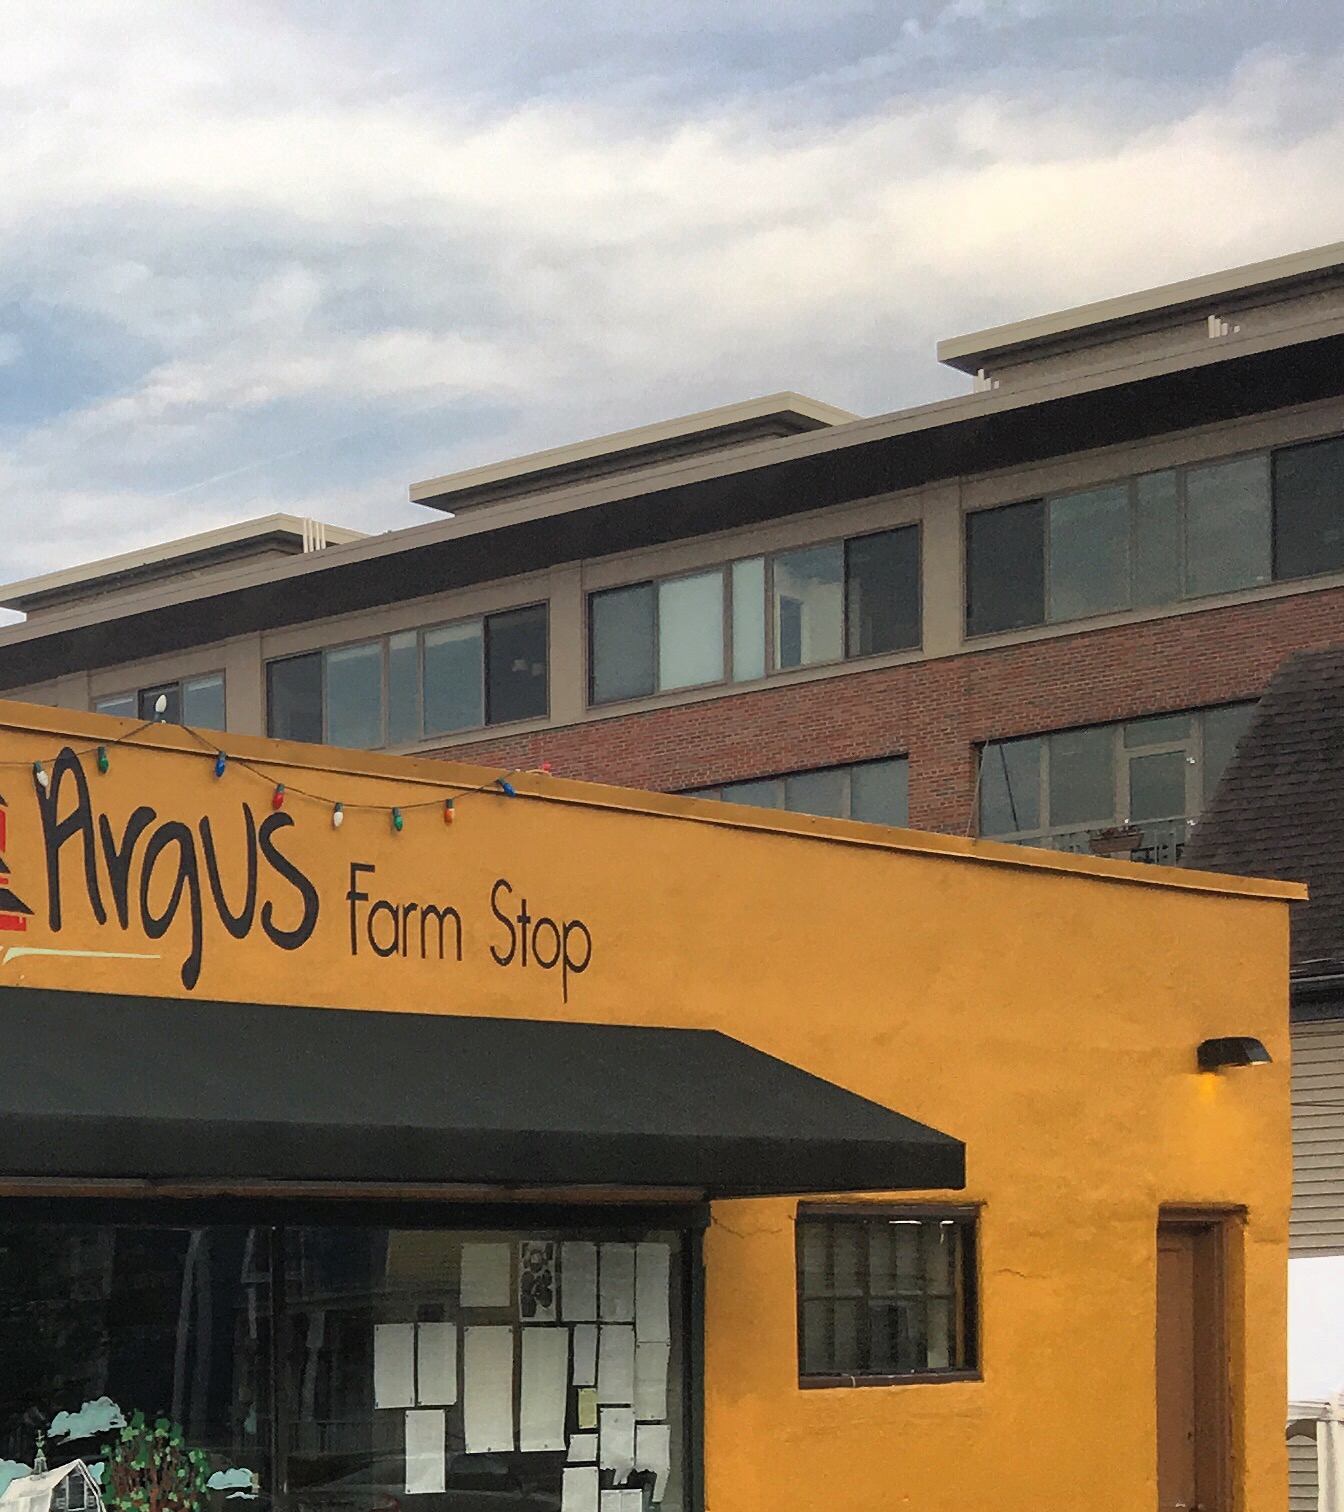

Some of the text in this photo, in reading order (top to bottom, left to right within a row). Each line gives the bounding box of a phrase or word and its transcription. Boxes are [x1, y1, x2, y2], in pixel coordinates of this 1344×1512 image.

[36, 746, 593, 1003] Argus Farm Stop
